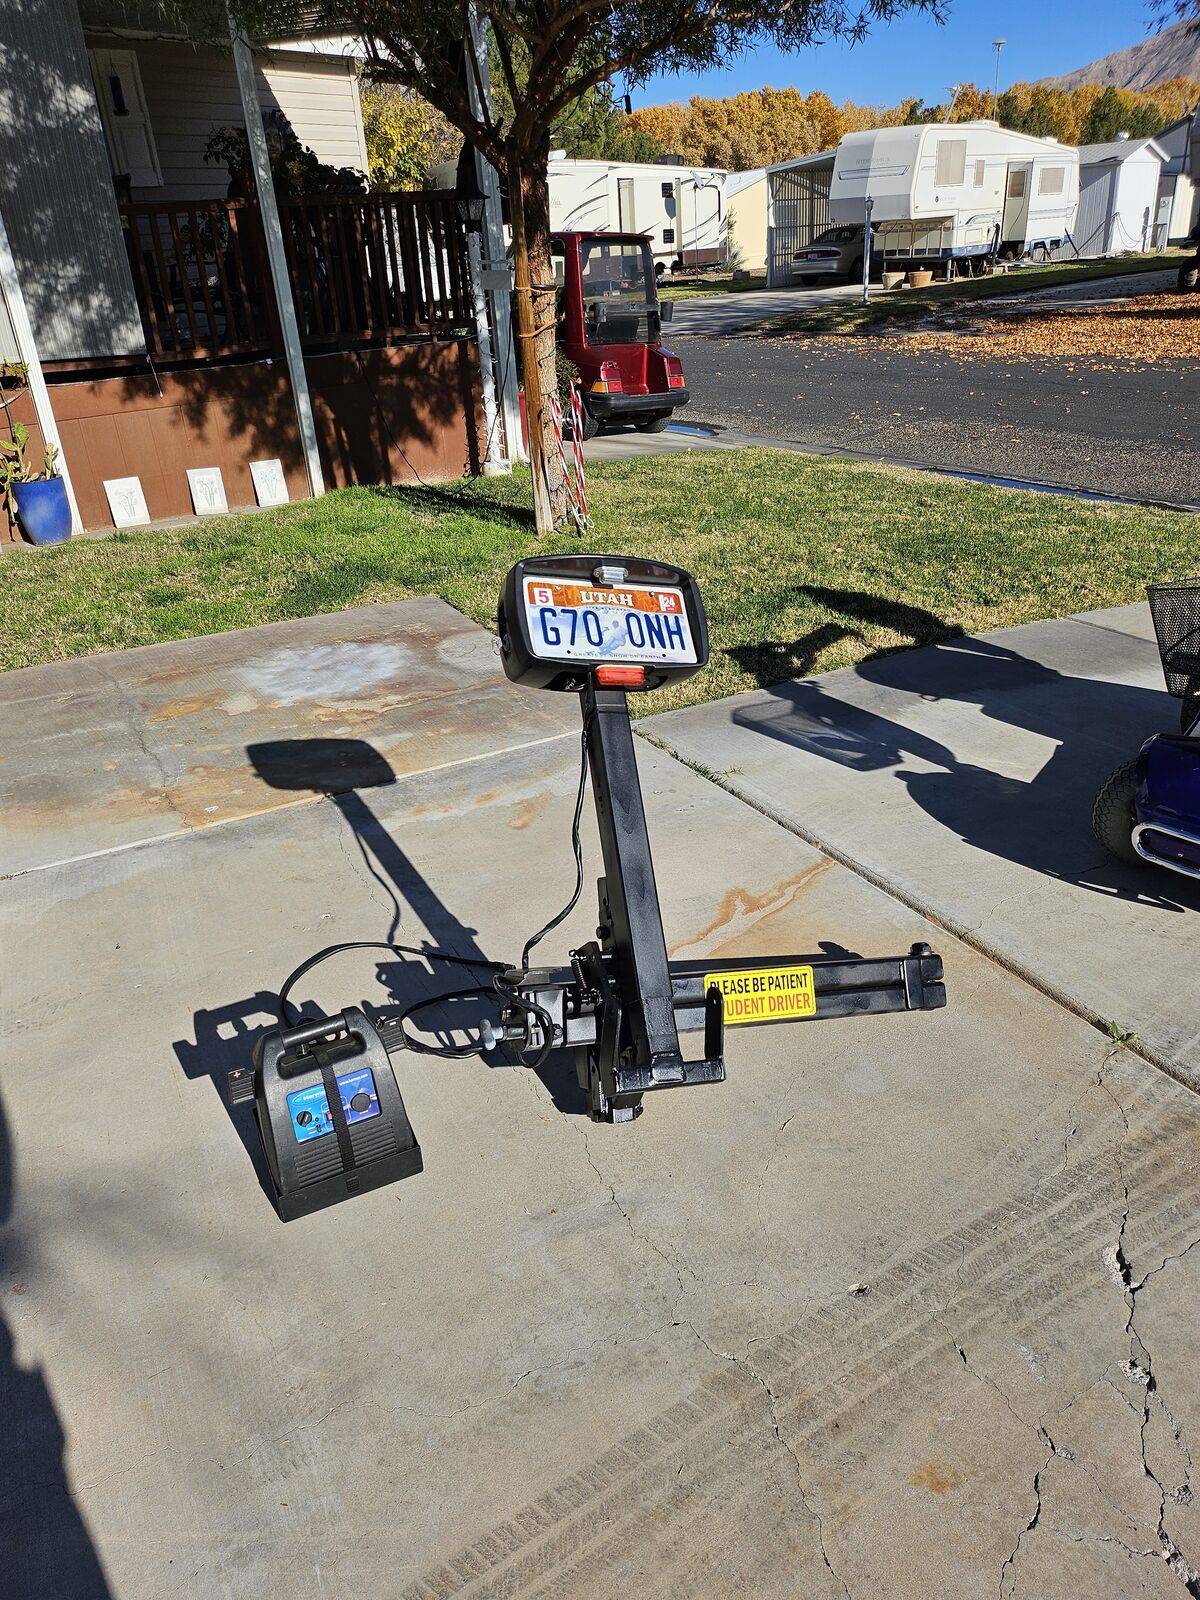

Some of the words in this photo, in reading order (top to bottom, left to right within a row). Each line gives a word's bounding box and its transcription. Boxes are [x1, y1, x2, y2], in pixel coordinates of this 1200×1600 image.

[538, 590, 550, 603] 5
[579, 590, 633, 606] UTAH
[664, 596, 676, 609] 24
[539, 607, 604, 647] G70
[752, 977, 766, 993] BE
[768, 973, 808, 991] PATIENT
[724, 997, 765, 1017] UDENT
[768, 992, 811, 1013] DRIVER
